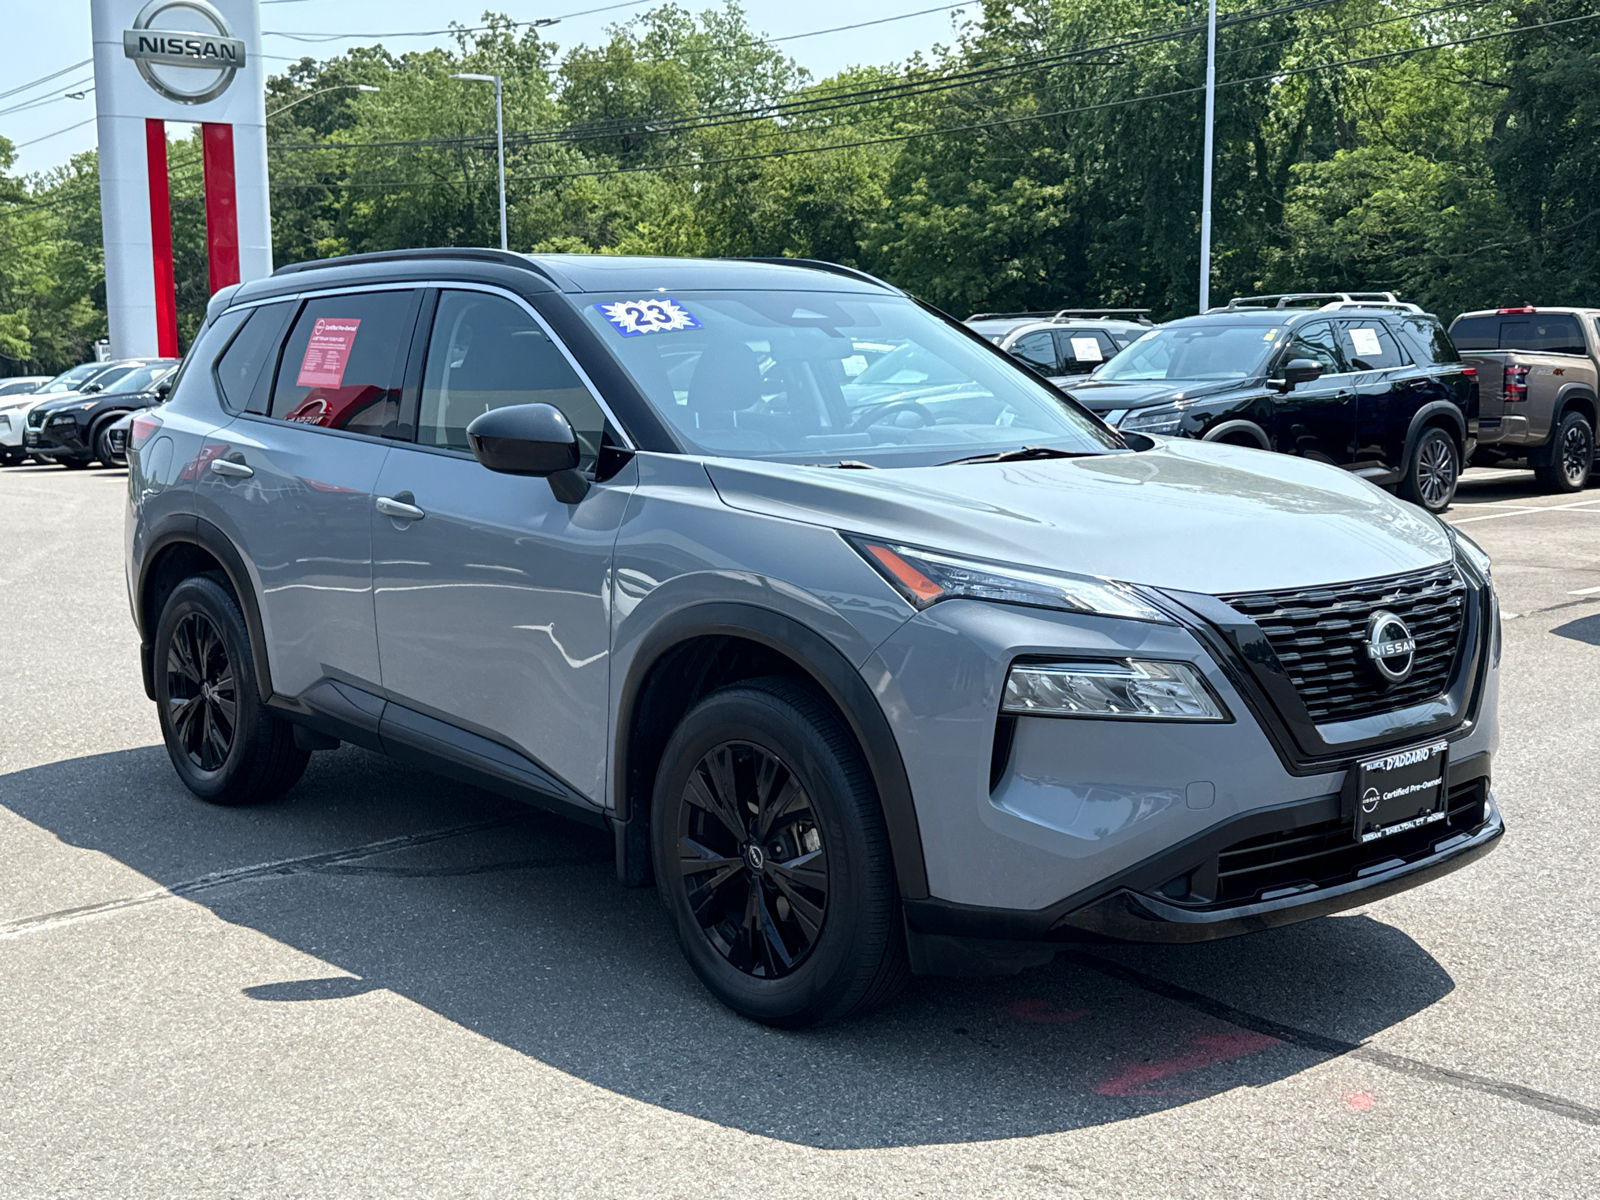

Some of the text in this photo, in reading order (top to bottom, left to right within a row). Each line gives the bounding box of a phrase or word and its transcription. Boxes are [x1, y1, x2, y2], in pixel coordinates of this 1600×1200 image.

[138, 37, 237, 61] NISSAN
[625, 304, 672, 326] 23
[1370, 639, 1416, 657] NISSAN
[1386, 748, 1429, 771] D'ADDARIO
[1383, 776, 1442, 800] Certified Pre-Owned
